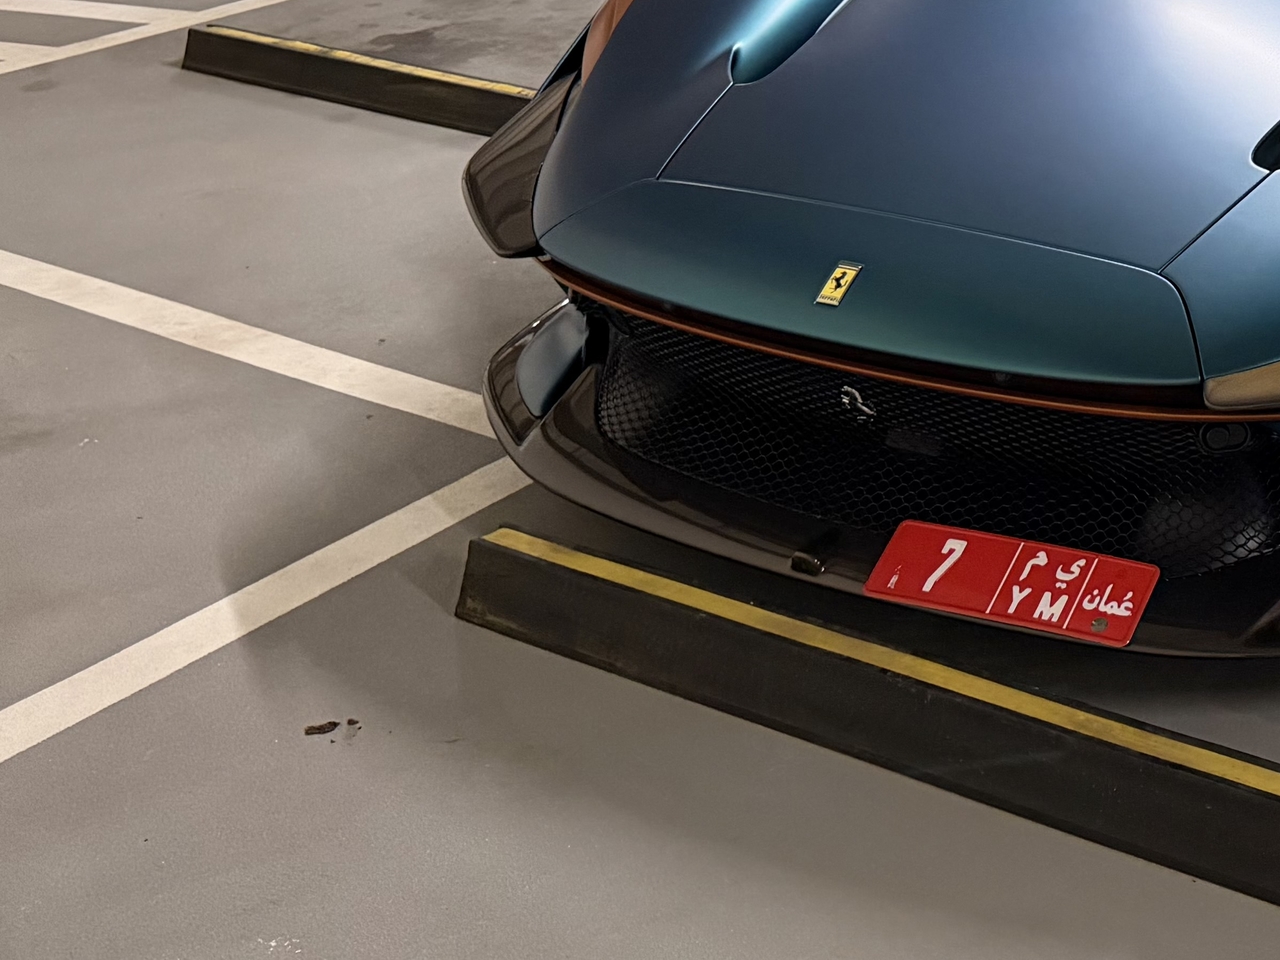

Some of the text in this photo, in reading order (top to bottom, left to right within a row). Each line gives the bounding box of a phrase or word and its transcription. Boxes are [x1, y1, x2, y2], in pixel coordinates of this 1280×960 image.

[922, 538, 968, 592] 7
[1007, 584, 1069, 622] Y M
